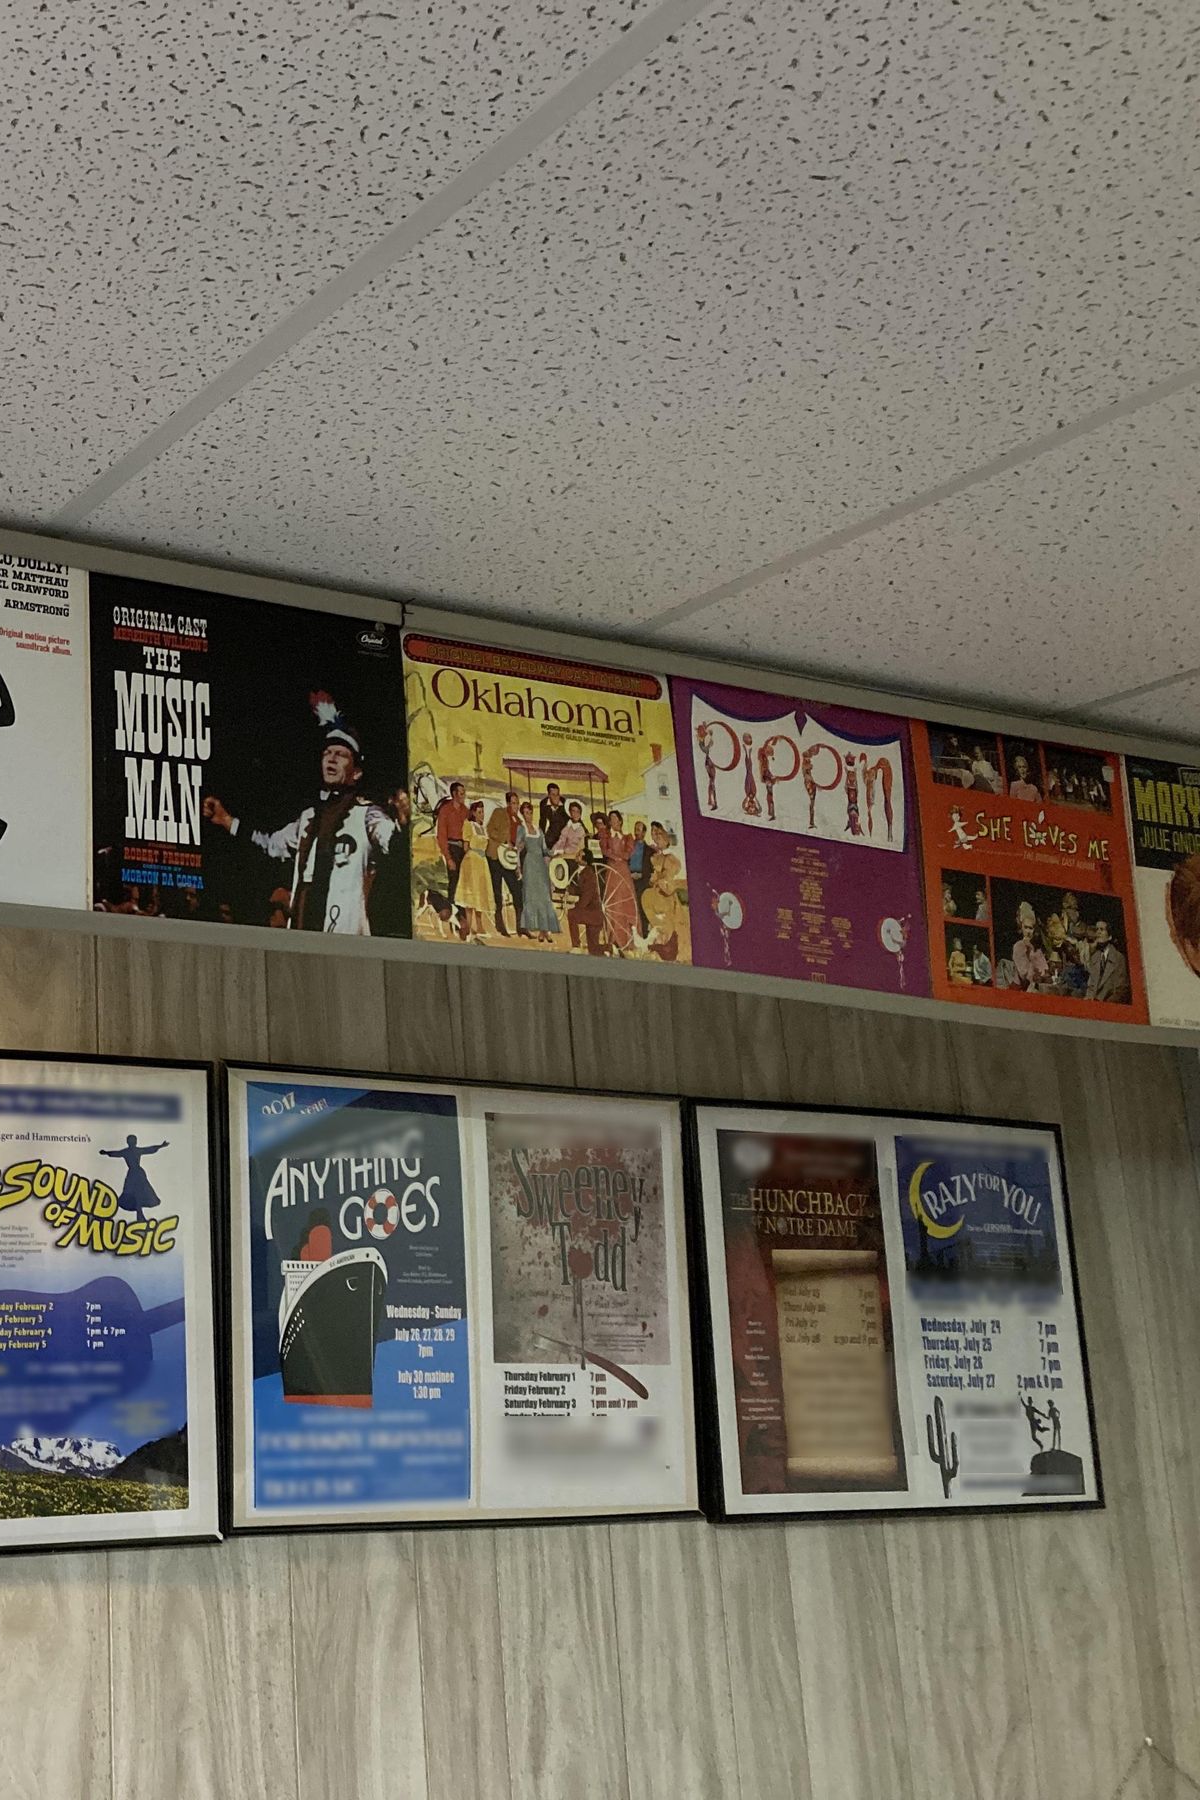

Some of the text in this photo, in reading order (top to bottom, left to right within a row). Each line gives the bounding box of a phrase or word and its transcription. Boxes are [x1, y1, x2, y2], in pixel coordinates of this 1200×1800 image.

[12, 570, 68, 588] MATTHAU
[12, 582, 68, 599] CRAWFORD
[4, 599, 70, 617] ARMSTRONG
[113, 606, 208, 638] ORIGINAL CAST
[16, 641, 50, 653] soundtrack
[24, 633, 46, 643] motion
[48, 634, 70, 646] picture
[142, 646, 181, 673] THE
[427, 646, 492, 666] ORIGINAL
[492, 652, 563, 677] BROADWAY
[566, 667, 594, 683] CAST
[431, 668, 644, 736] Oklahoma!
[114, 670, 211, 760] MUSIC
[124, 756, 202, 846] MAN
[976, 811, 1110, 861] SHE LOVES ME
[122, 868, 159, 885] MORTON
[162, 872, 174, 886] DA
[15, 1132, 30, 1141] and
[32, 1132, 92, 1144] Hammerstein's
[510, 1149, 645, 1243] Sweeney
[748, 1188, 869, 1216] HUNCHBACK
[978, 1172, 1000, 1192] FOR
[1001, 1178, 1042, 1226] YOU
[44, 1203, 78, 1228] OF
[339, 1176, 441, 1241] GOES
[764, 1216, 858, 1238] NOTRE DAME
[15, 1302, 47, 1312] February
[48, 1302, 54, 1311] 2
[86, 1302, 101, 1312] 7pm
[386, 1304, 462, 1320] Wednesday Sunday
[4, 1315, 36, 1325] February
[38, 1315, 43, 1323] 3
[86, 1314, 101, 1325] 7pm
[970, 1319, 986, 1336] July
[14, 1328, 46, 1338] February
[47, 1328, 52, 1336] 4
[86, 1327, 101, 1337] 1pm
[103, 1327, 109, 1335] &
[110, 1326, 126, 1337] 7pm
[395, 1328, 410, 1342] July
[446, 1328, 456, 1342] 29
[8, 1340, 40, 1350] February
[41, 1340, 47, 1348] 5
[418, 1344, 434, 1358] 7pm
[964, 1337, 980, 1354] July
[982, 1338, 992, 1352] 25
[398, 1370, 454, 1384] July 30 matinee
[504, 1371, 576, 1382] Thursday February 1
[413, 1386, 442, 1400] 1:30 pm
